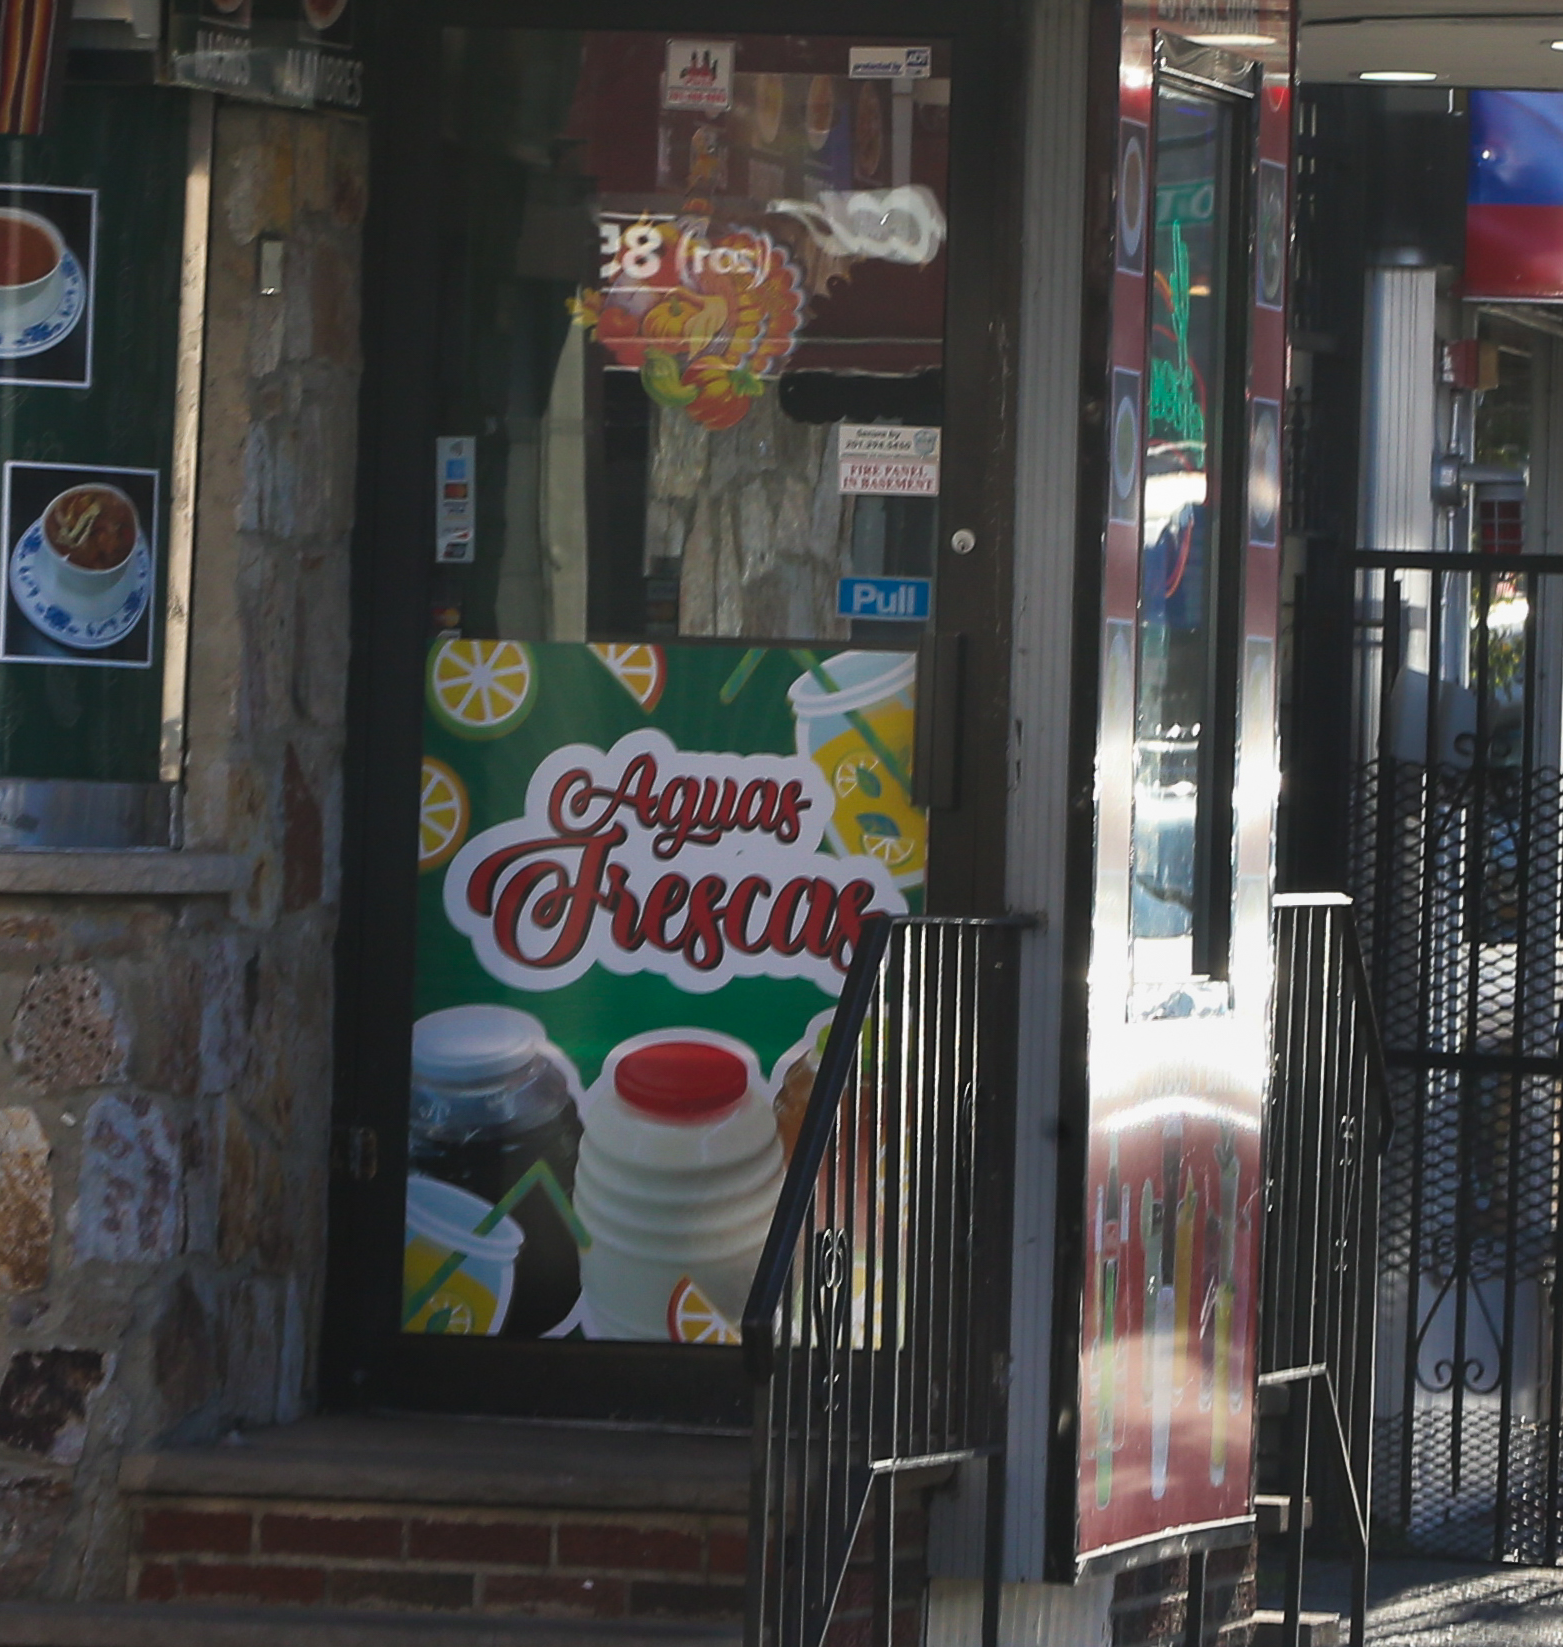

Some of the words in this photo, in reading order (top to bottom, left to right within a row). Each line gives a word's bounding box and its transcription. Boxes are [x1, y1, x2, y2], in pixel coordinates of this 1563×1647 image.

[852, 583, 917, 616] Pull
[547, 751, 812, 862] Aguas
[465, 823, 893, 973] Frescas
